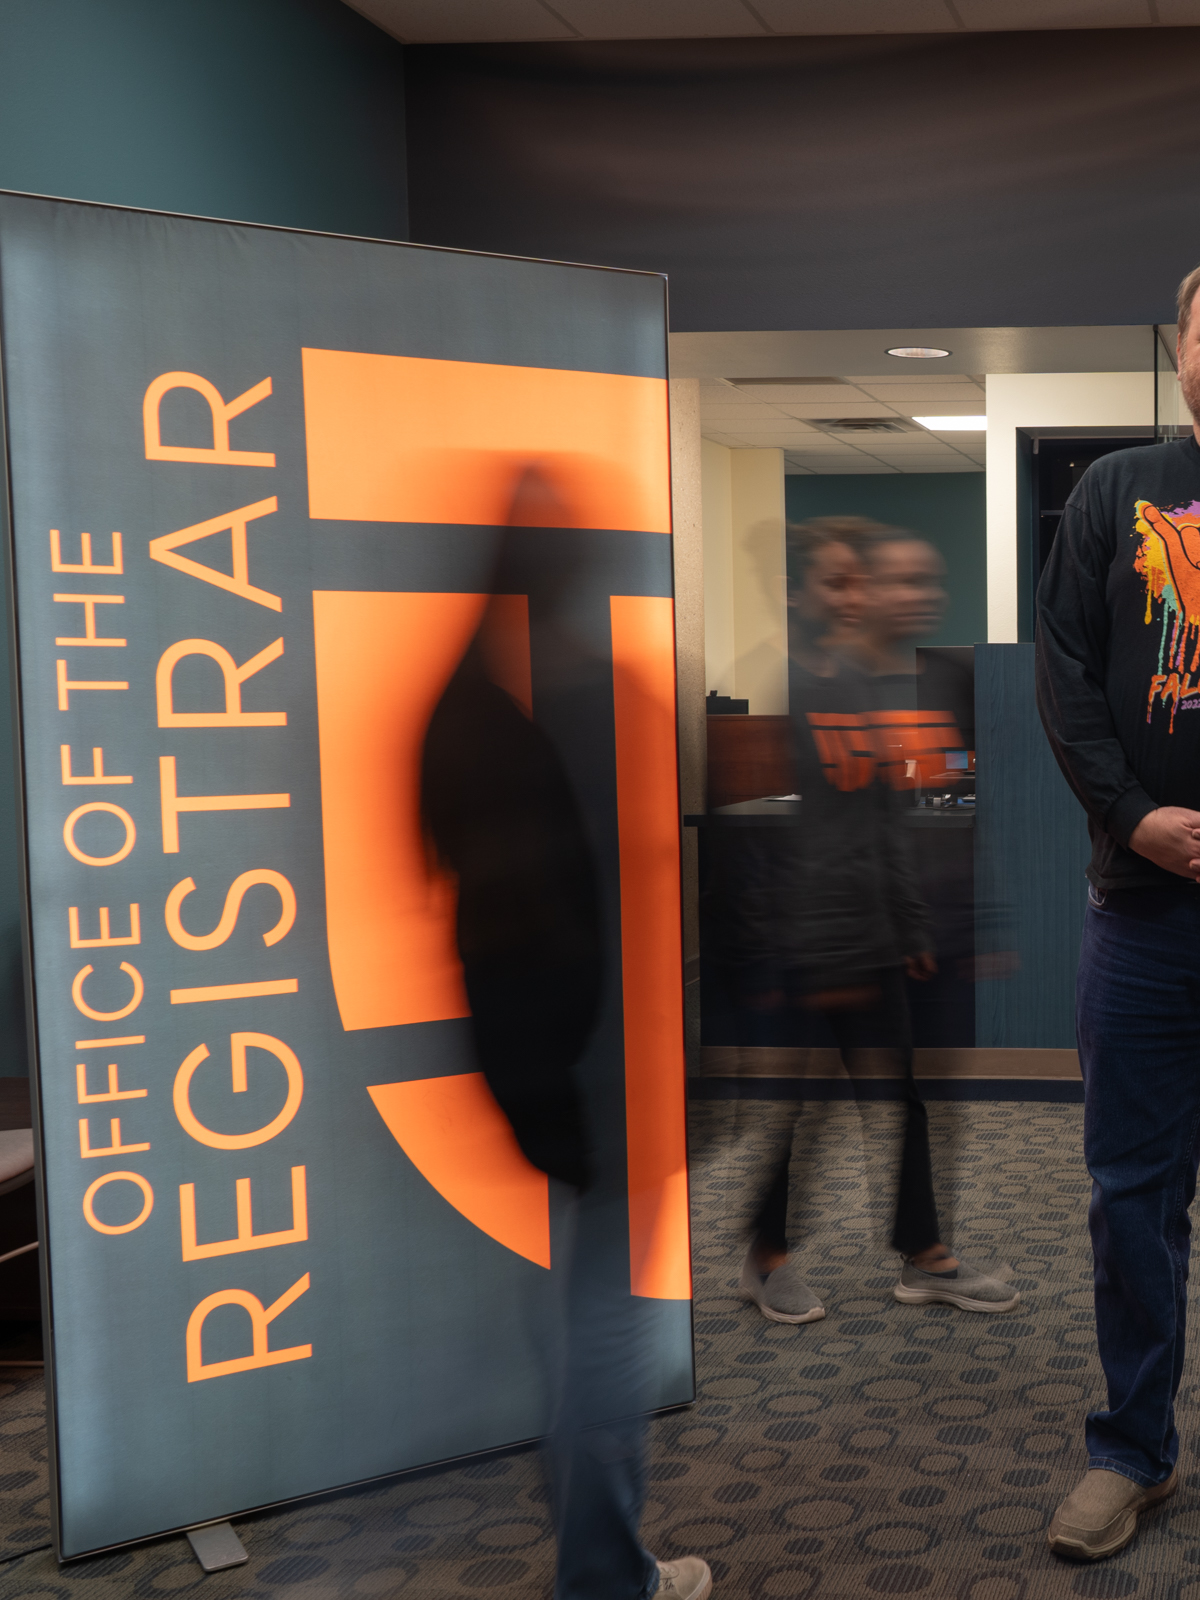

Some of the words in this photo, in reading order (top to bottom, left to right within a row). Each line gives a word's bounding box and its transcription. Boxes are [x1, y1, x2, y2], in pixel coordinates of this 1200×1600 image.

[50, 529, 129, 711] THE
[60, 744, 136, 867] OF
[142, 371, 312, 1384] REGISTRAR
[69, 903, 153, 1235] OFFICE
